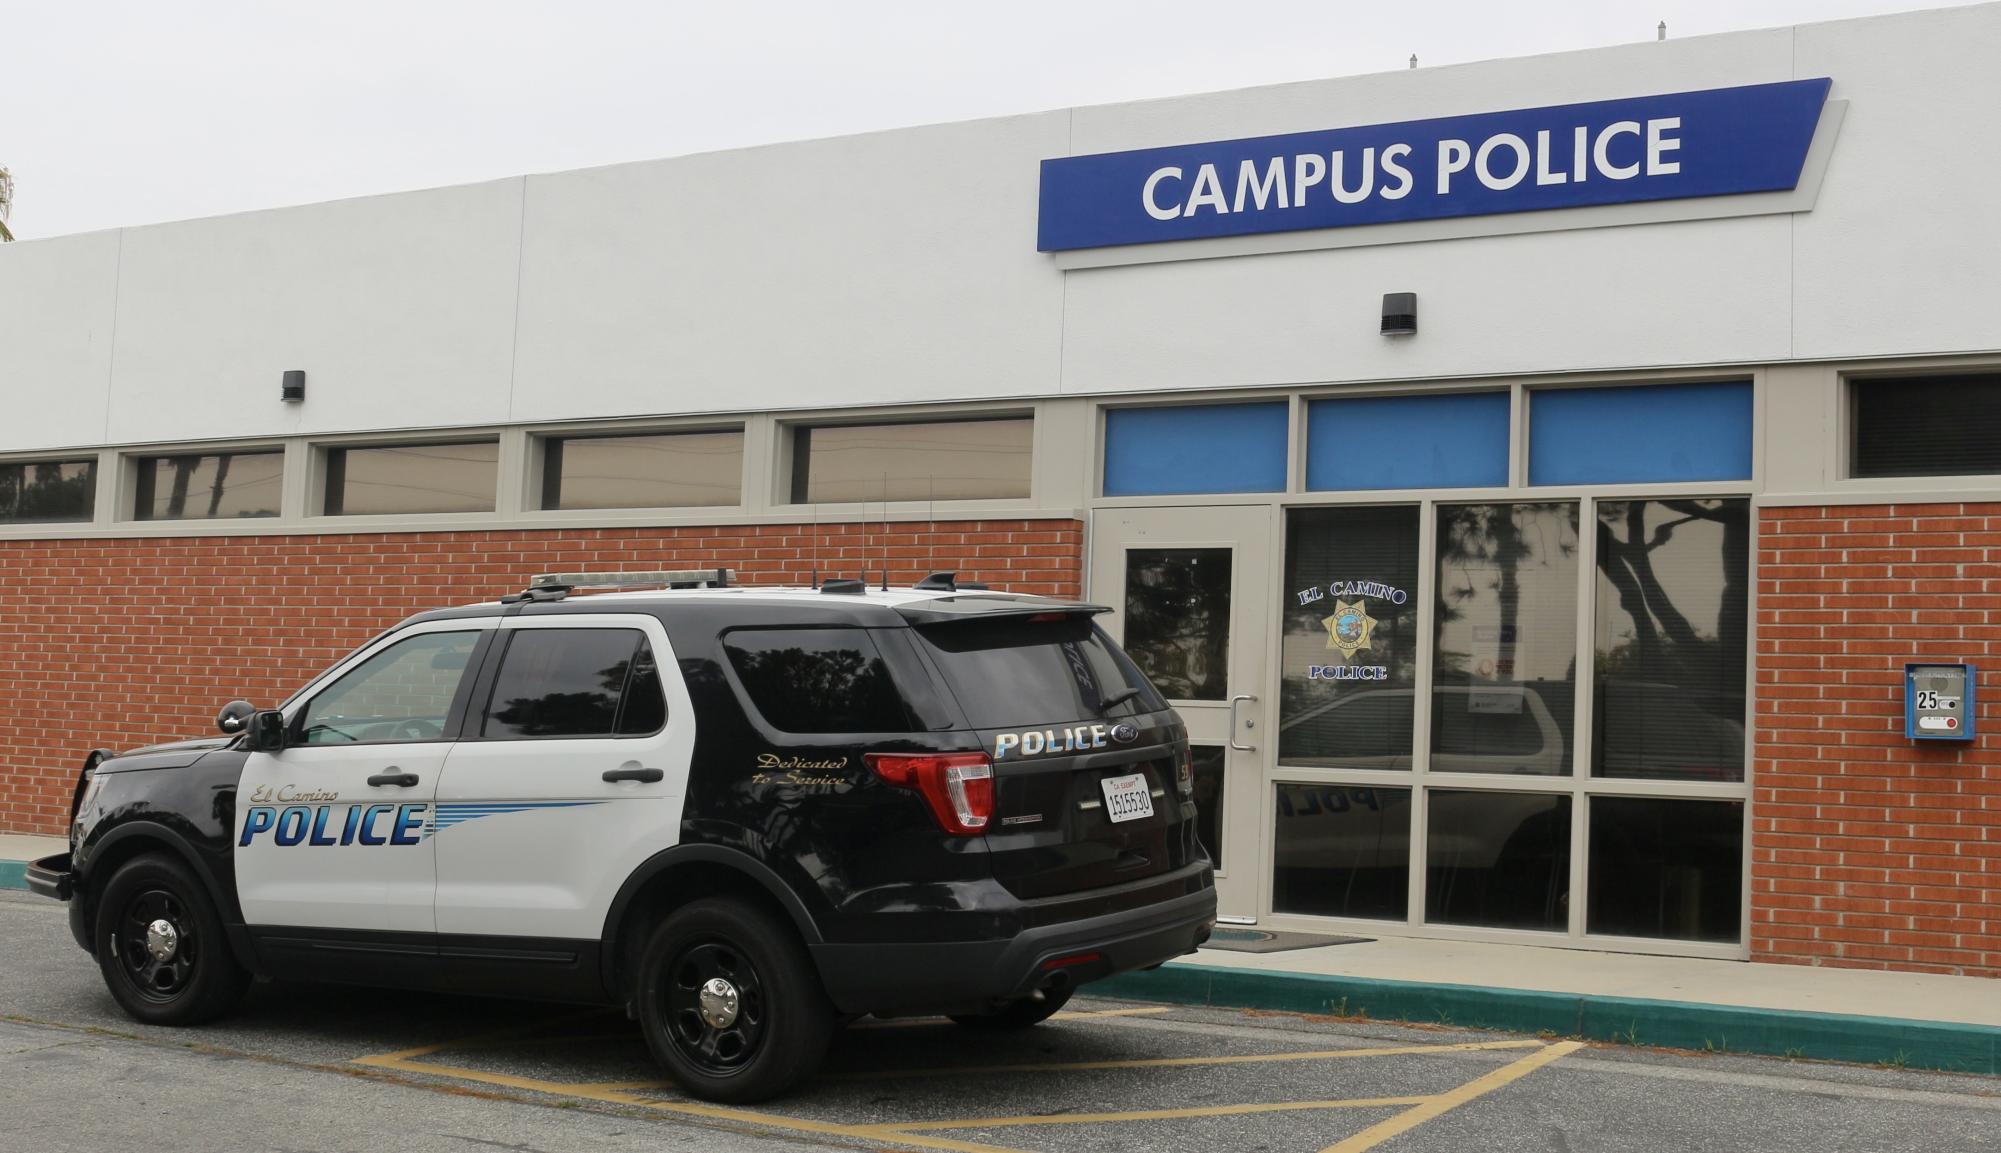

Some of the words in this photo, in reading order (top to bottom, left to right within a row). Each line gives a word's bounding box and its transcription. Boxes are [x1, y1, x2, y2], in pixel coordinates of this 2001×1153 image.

[1142, 143, 1413, 221] CAMPUS
[1438, 117, 1682, 195] POLICE
[1297, 586, 1324, 605] EL
[1330, 581, 1407, 605] CAMINO
[1308, 666, 1388, 680] POLICE
[1918, 692, 1938, 709] 25
[994, 725, 1108, 759] POLICE
[757, 753, 848, 769] Dedicated
[752, 773, 771, 784] to
[776, 770, 846, 785] Service
[250, 784, 273, 802] El
[277, 784, 339, 802] Camino
[1109, 790, 1150, 816] 1515530
[239, 804, 428, 847] POLICE
